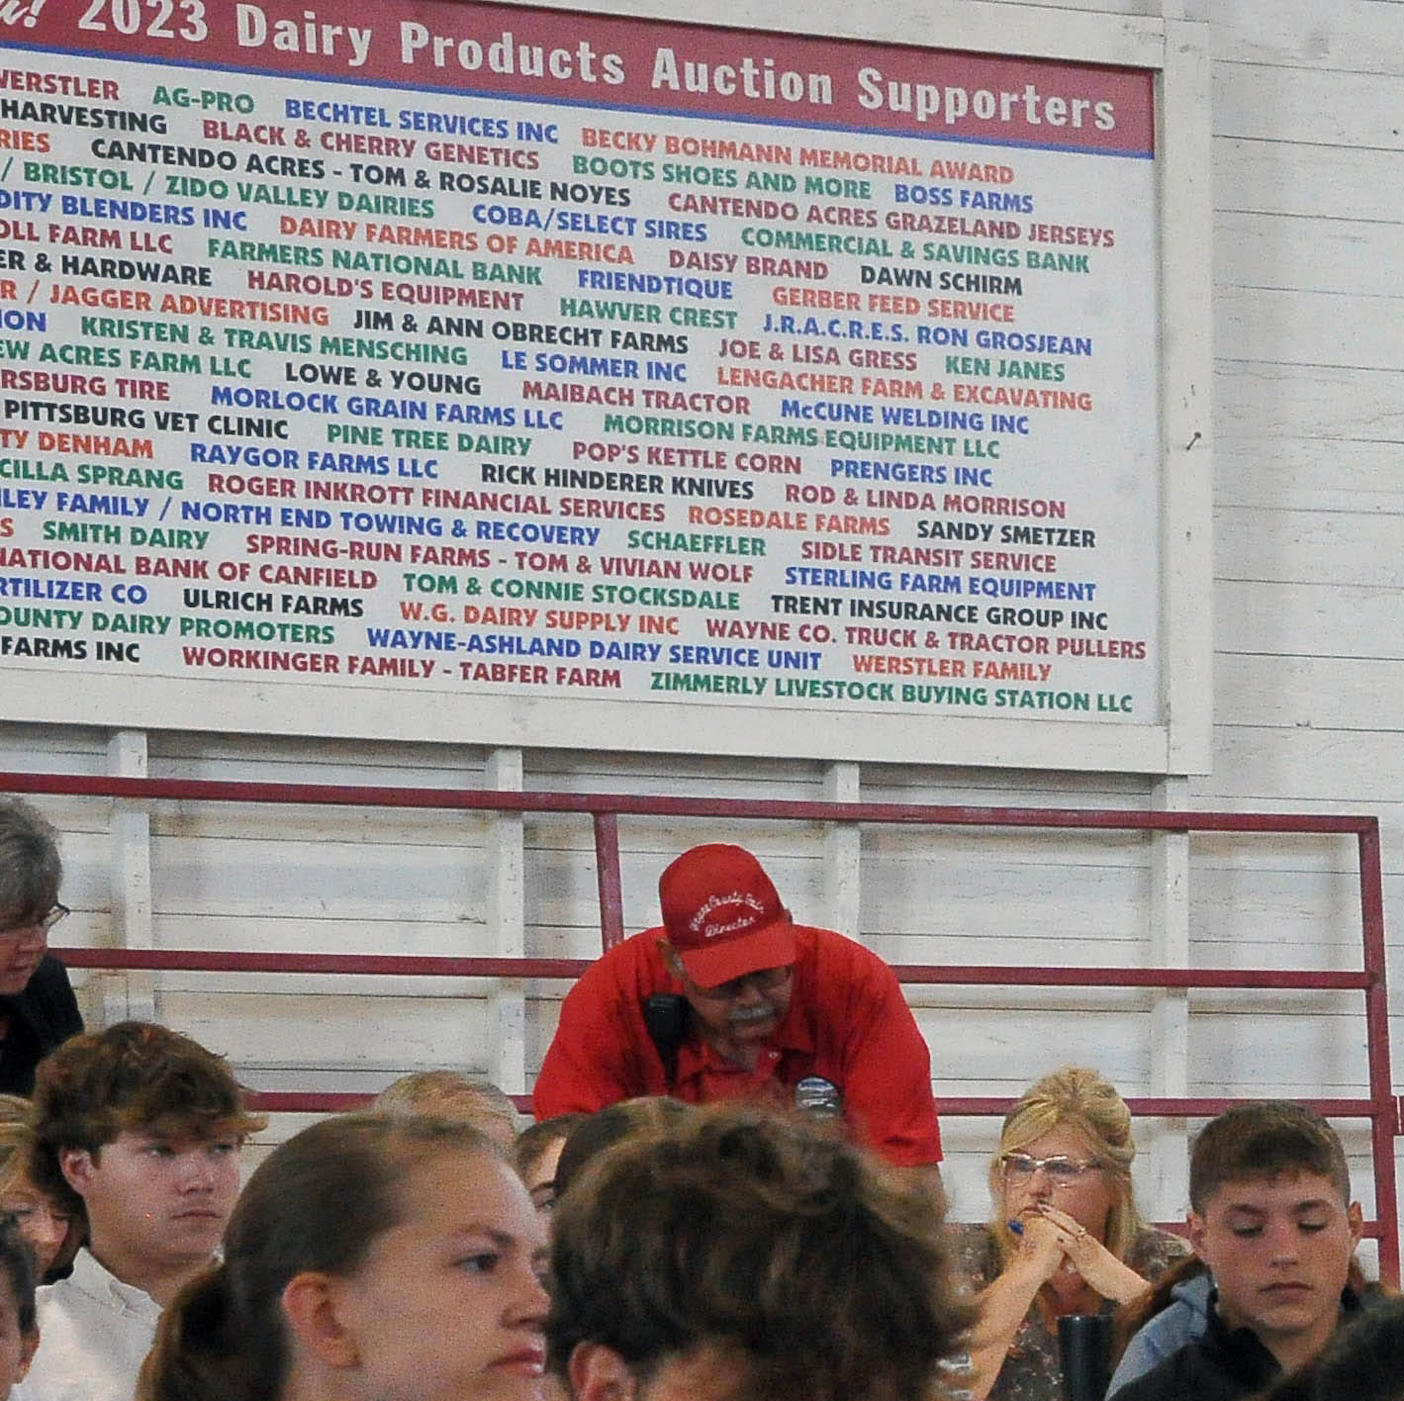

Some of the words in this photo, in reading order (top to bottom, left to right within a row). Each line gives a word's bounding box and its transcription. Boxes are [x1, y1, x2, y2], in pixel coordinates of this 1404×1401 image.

[78, 0, 208, 42] 2023
[237, 3, 372, 66] Dairy
[400, 21, 625, 85] Products
[652, 47, 833, 105] Auction
[858, 67, 1116, 131] Supporters
[0, 97, 168, 135] HARVESTING
[150, 84, 256, 115] AG-PRO
[283, 97, 393, 129] BECHTEL
[397, 108, 510, 140] SERVICES
[515, 120, 559, 145] INC
[580, 126, 658, 153] BECKY
[663, 134, 792, 166] BOHMANN
[798, 146, 923, 177] MEMORIAL
[928, 158, 1014, 185] AWARD
[571, 153, 656, 181] BOOTS
[660, 161, 739, 189] SHOES
[743, 169, 797, 193] AND
[802, 174, 872, 201] MORE
[893, 182, 954, 208] BOSS
[958, 188, 1034, 214] FARMS
[470, 202, 638, 237] COBA/SELECT
[643, 217, 708, 243] SIRES
[667, 191, 800, 222] CANTENDO
[805, 203, 878, 229] ACRES
[883, 210, 1022, 240] GRAZELAND
[1026, 222, 1115, 248] JERSEYS
[278, 213, 358, 241] DAIRY
[364, 221, 479, 252] FARMERS
[484, 232, 518, 255] OF
[523, 236, 635, 265] AMERICA
[739, 225, 894, 259] COMMERCIAL
[898, 239, 916, 260] &
[921, 240, 1021, 269] SAVINGS
[1025, 249, 1090, 274] BANK
[206, 236, 325, 268] FARMERS
[330, 247, 466, 280] NATIONAL
[470, 259, 543, 287] BANK
[667, 248, 739, 274] DAISY
[744, 254, 829, 281] BRAND
[859, 263, 933, 290] DAWN
[937, 270, 1023, 297] SCHIRM
[246, 268, 374, 300] HAROLD'S
[380, 279, 525, 312] EQUIPMENT
[576, 267, 734, 301] FRIENDTIQUE
[558, 295, 663, 325] HAWVER
[667, 305, 739, 331] CREST
[771, 285, 862, 312] GERBER
[867, 292, 921, 316] FEED
[926, 297, 1015, 323] SERVICE
[761, 312, 910, 343] J.R.A.C.R.E.S.
[915, 324, 969, 348] RON
[974, 328, 1093, 357] GROSJEAN
[499, 348, 528, 371] LE
[533, 351, 640, 380] SOMMER
[645, 359, 688, 383] INC
[944, 354, 991, 377] KEN
[995, 357, 1066, 383] JANES
[209, 383, 340, 415] MORLOCK
[345, 394, 428, 422] GRAIN
[434, 401, 517, 428] FARMS
[522, 407, 564, 432] LLC
[521, 379, 635, 408] MAIBACH
[640, 388, 751, 416] TRACTOR
[779, 397, 875, 425] McCUNE
[879, 404, 985, 432] WELDING
[989, 412, 1030, 436] INC
[2, 397, 146, 430] PITTSBURG
[152, 409, 200, 434] VET
[206, 413, 289, 441] CLINIC
[601, 411, 735, 442] MORRISON
[740, 421, 821, 448] FARMS
[823, 427, 957, 456] EQUIPMENT
[962, 436, 1000, 460] LLC
[325, 421, 385, 447] PINE
[389, 426, 450, 452] TREE
[456, 431, 533, 457] DAIRY
[571, 439, 640, 465] POP'S
[645, 444, 728, 471] KETTLE
[733, 451, 802, 476] CORN
[188, 441, 301, 470] RAYGOR
[306, 449, 391, 477] FARMS
[396, 456, 439, 480] LLC
[829, 457, 948, 485] PRENGERS
[952, 465, 993, 488] INC
[207, 471, 297, 499] ROGER
[303, 478, 415, 507] INKROTT
[420, 486, 553, 516] FINANCIAL
[558, 495, 666, 523] SERVICES
[479, 462, 538, 487] RICK
[542, 466, 665, 495] HINDERER
[670, 474, 755, 501] KNIVES
[784, 482, 836, 505] ROD
[841, 486, 859, 507] &
[865, 487, 937, 512] LINDA
[941, 492, 1066, 520] MORRISON
[41, 519, 122, 546] SMITH
[128, 525, 211, 551] DAIRY
[687, 504, 808, 532] ROSEDALE
[814, 512, 891, 537] FARMS
[915, 518, 995, 543] SANDY
[999, 523, 1096, 549] SMETZER
[626, 527, 767, 557] SCHAEFFLER
[800, 539, 863, 563] SIDLE
[868, 543, 965, 569] TRANSIT
[969, 549, 1057, 574] SERVICE
[783, 564, 894, 591] STERLING
[898, 571, 963, 595] FARM
[967, 575, 1098, 602] EQUIPMENT
[181, 586, 274, 613] ULRICH
[279, 592, 365, 619] FARMS
[398, 599, 456, 624] W.G.
[462, 603, 539, 628] DAIRY
[543, 608, 632, 633] SUPPLY
[637, 613, 680, 636] INC
[769, 593, 844, 617] TRENT
[848, 597, 980, 625] INSURANCE
[984, 605, 1065, 629] GROUP
[1069, 609, 1109, 632] INC
[364, 626, 582, 658] WAYNE-ASHLAND
[587, 638, 663, 663] DAIRY
[667, 643, 761, 668] SERVICE
[765, 647, 823, 671] UNIT
[851, 652, 967, 678] WERSTLER
[971, 658, 1053, 682] FAMILY
[648, 670, 769, 696] ZIMMERLY
[773, 676, 896, 702] LIVESTOCK
[900, 682, 989, 707] BUYING
[993, 687, 1091, 712] STATION
[1095, 692, 1133, 714] LLC
[705, 916, 755, 937] Director
